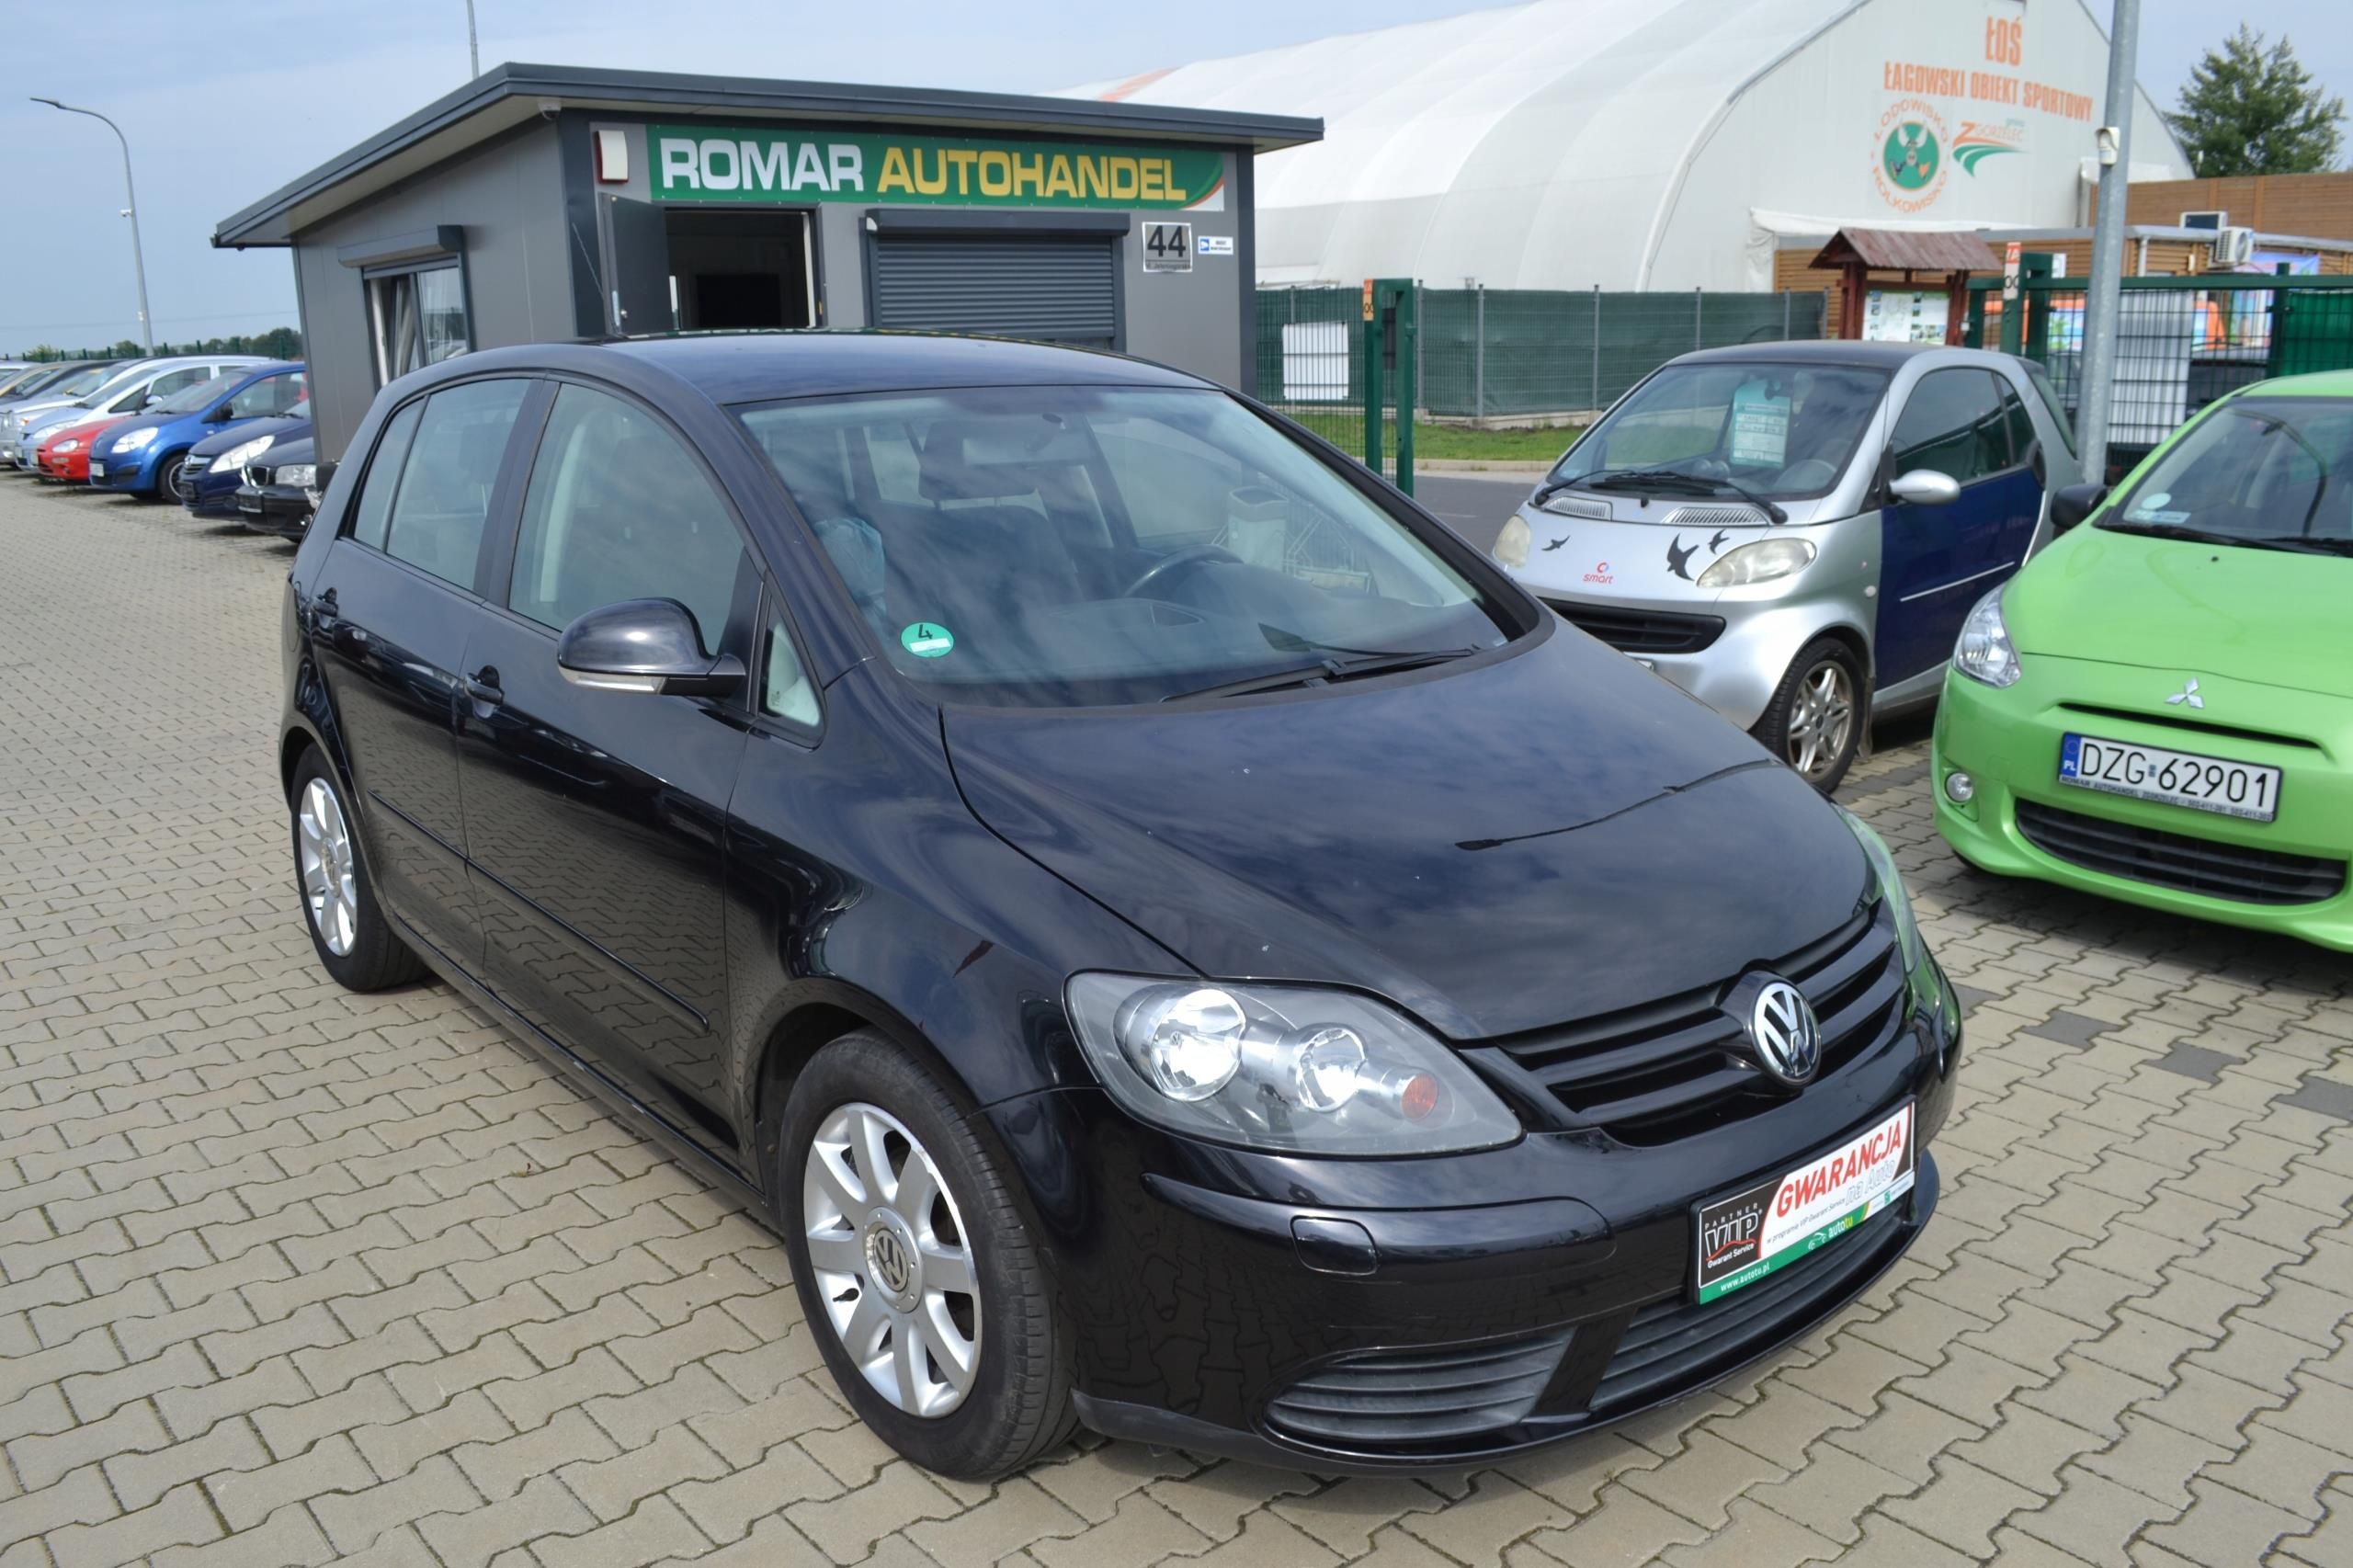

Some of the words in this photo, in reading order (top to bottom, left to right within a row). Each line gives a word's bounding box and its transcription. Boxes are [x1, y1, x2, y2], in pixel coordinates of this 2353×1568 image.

[1985, 16, 2022, 66] ŁOŚ
[1884, 61, 1965, 97] ŁAGOWSKI
[1971, 71, 2019, 106] OBIEKT
[2023, 81, 2094, 122] SPORTOWY
[660, 138, 864, 192] ROMAR
[878, 147, 1187, 201] AUTOHANDEL
[1147, 225, 1186, 257] 44
[1583, 574, 1614, 585] smart
[918, 624, 933, 640] 4
[2063, 760, 2076, 772] PL
[2081, 743, 2146, 785] DZG
[2158, 758, 2268, 808] 62901
[1777, 1120, 1901, 1218] GWARANCJA
[1705, 1202, 1758, 1231] PARTNER
[1705, 1212, 1758, 1257] VIP
[1708, 1251, 1733, 1268] Gwarant
[1733, 1243, 1755, 1257] Service
[1721, 1261, 1770, 1292] www.autotu.pl
